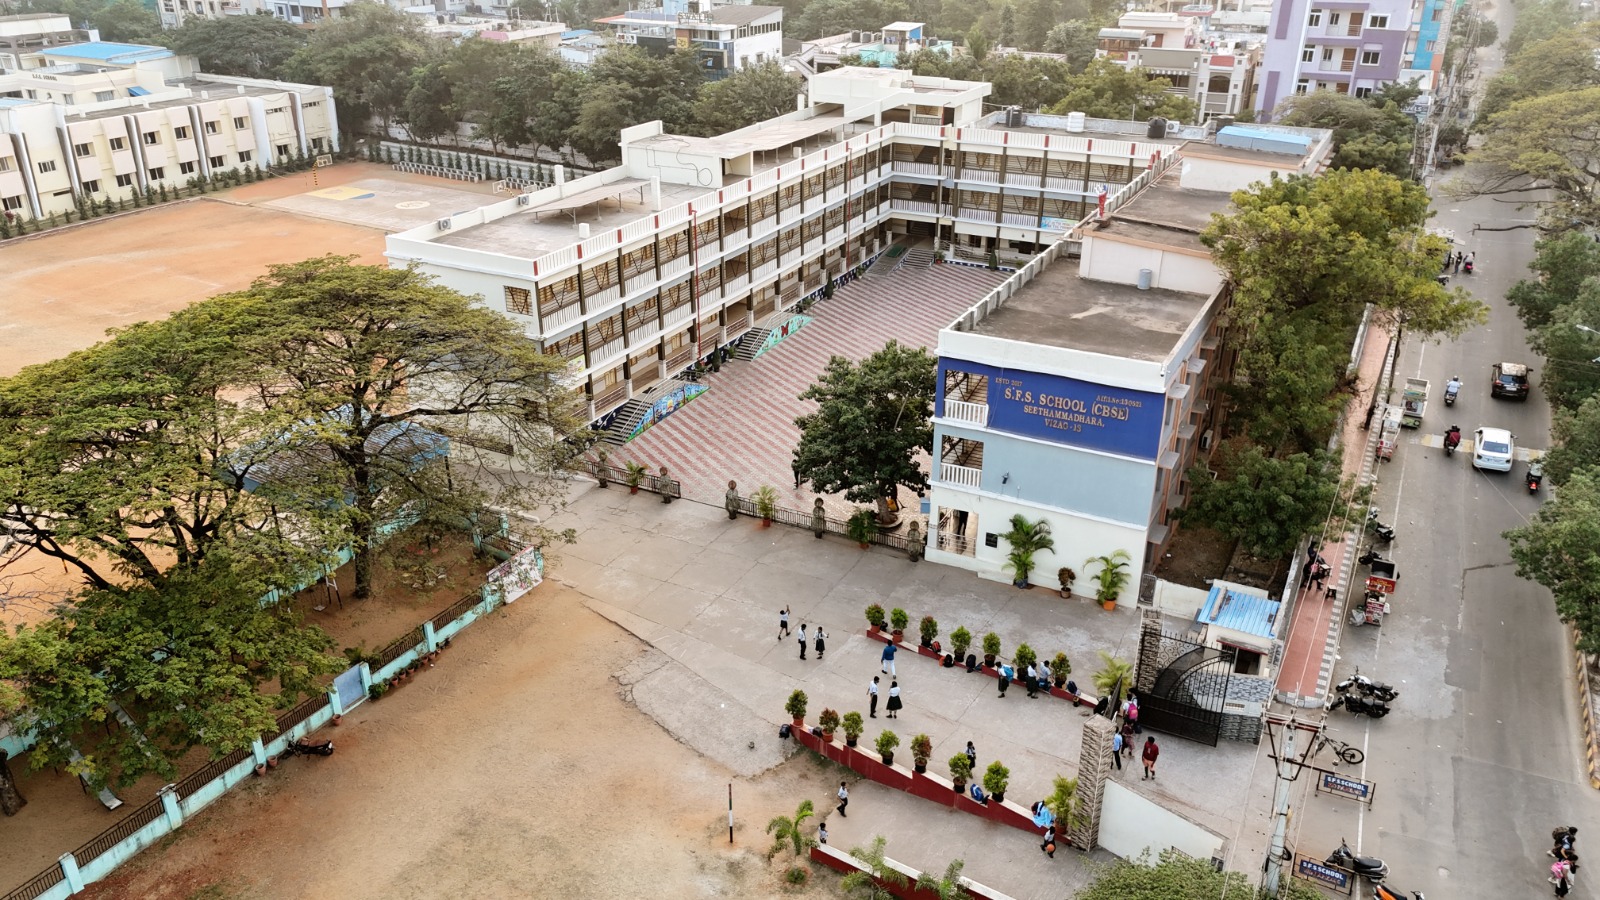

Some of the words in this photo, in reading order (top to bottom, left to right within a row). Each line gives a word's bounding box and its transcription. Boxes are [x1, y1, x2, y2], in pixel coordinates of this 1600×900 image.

[1004, 387, 1035, 404] S.F.S.
[1039, 393, 1087, 413] SCHOOL
[1091, 401, 1129, 421] (CBSE)
